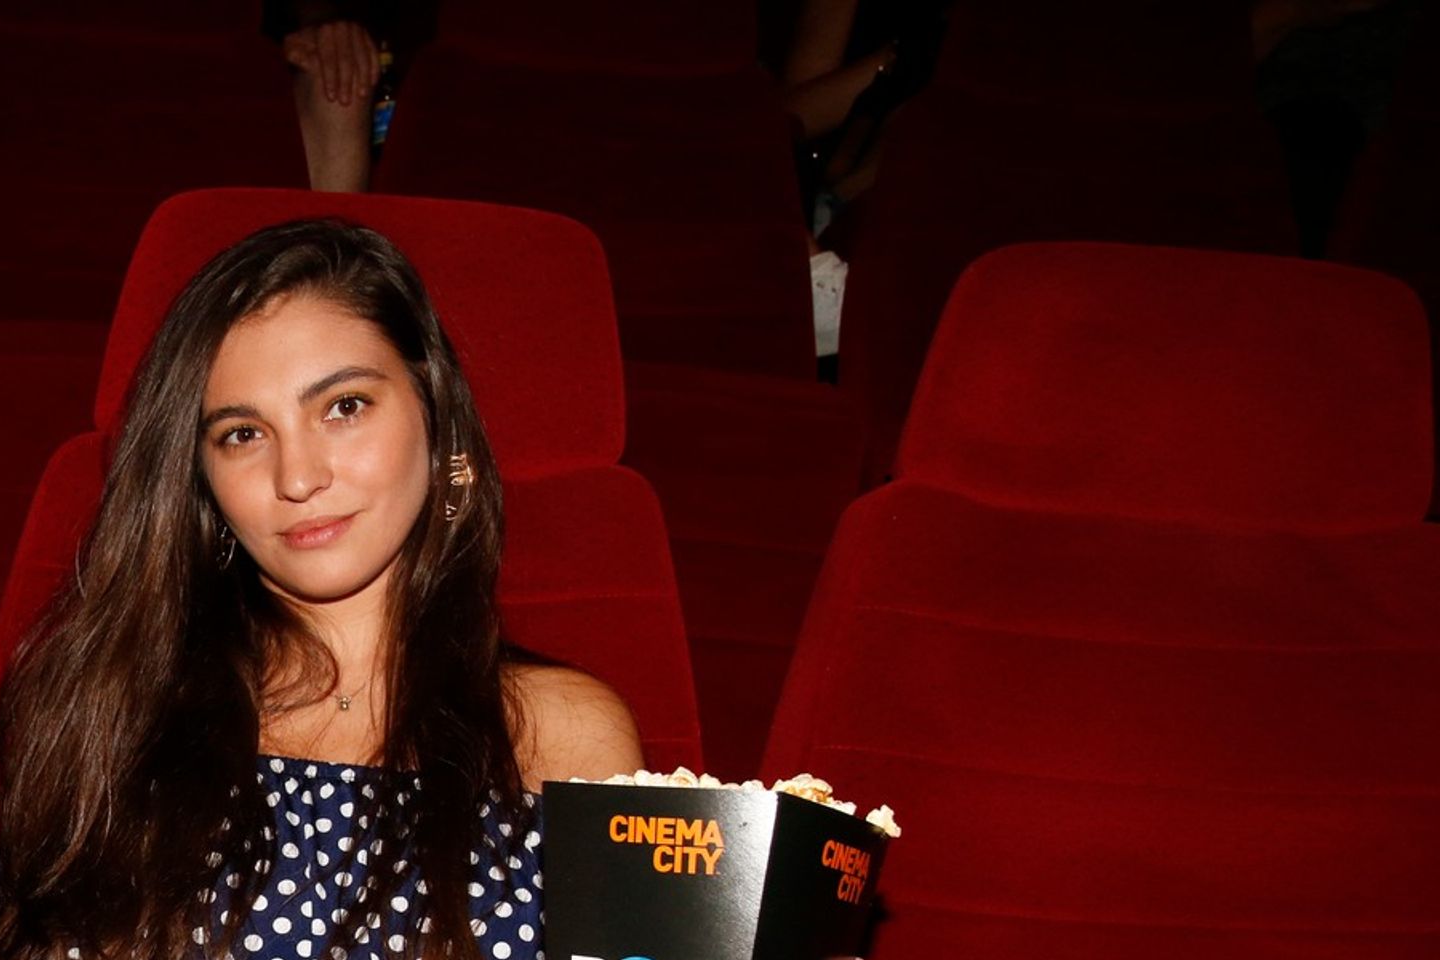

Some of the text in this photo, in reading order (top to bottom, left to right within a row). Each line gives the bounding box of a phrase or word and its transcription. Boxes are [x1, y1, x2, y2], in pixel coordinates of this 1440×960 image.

[610, 815, 724, 847] CINEMA
[653, 846, 725, 875] CITY
[821, 839, 871, 880] CINEMA
[837, 874, 865, 905] CITY
